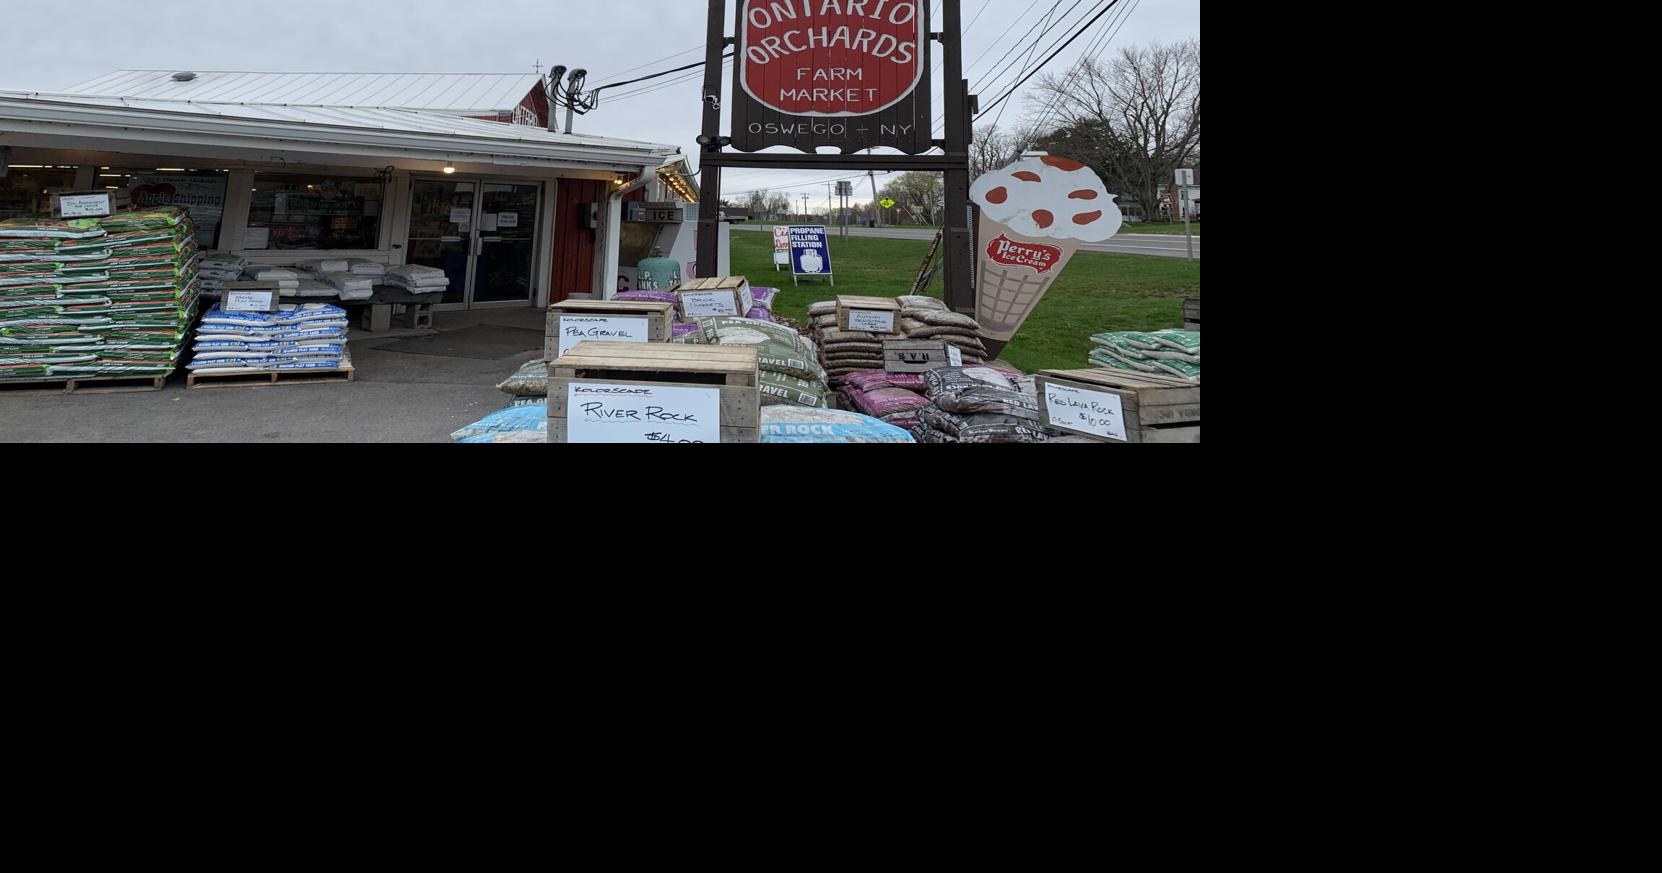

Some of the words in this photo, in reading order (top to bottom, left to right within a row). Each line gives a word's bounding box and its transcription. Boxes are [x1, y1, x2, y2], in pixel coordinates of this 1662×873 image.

[748, 0, 914, 29] ONTARIO
[747, 26, 916, 65] ORCHARDS
[797, 67, 863, 81] FARM
[780, 88, 878, 102] MARKET
[748, 122, 845, 135] OSWEGO
[880, 123, 912, 135] NY
[653, 211, 675, 220] ICE
[789, 227, 825, 235] PROPANE
[996, 239, 1052, 261] Perry's
[1016, 254, 1047, 268] Cream
[564, 326, 586, 338] PEA
[587, 327, 633, 340] GRAVEL
[574, 386, 654, 395] KOLORSCAPE
[1048, 393, 1067, 406] RED
[1091, 401, 1115, 416] ROCK
[580, 402, 641, 421] RIVER
[645, 405, 698, 423] ROCK
[785, 424, 833, 435] ROCK
